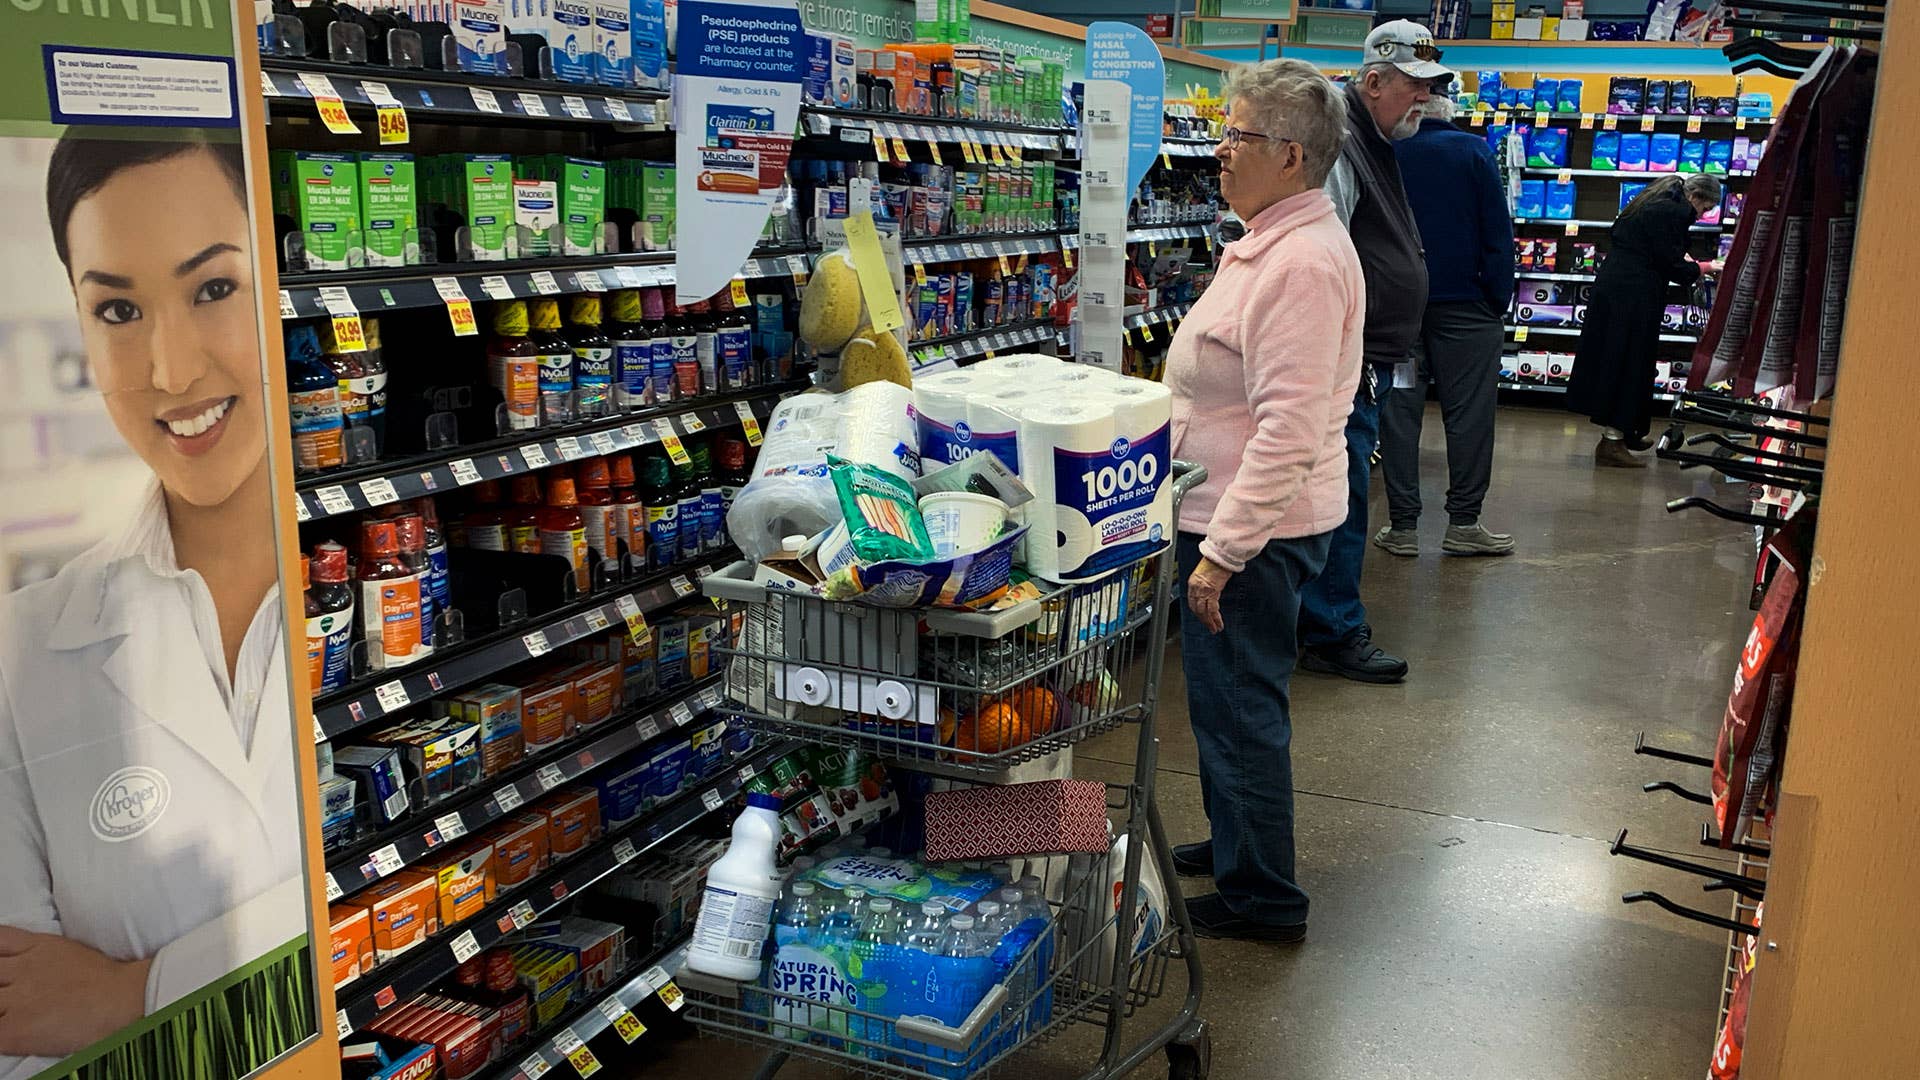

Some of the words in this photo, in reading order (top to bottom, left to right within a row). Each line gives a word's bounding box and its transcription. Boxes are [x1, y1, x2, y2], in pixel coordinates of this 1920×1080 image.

[461, 6, 498, 22] Mucinex
[554, 0, 590, 16] Mucinex
[596, 6, 628, 22] Mucinex
[701, 14, 798, 32] Pseudoephedrine
[819, 4, 859, 33] throat
[861, 10, 913, 41] remedies
[708, 29, 738, 41] (PSE)
[740, 33, 790, 45] products
[1093, 40, 1126, 50] NASAL
[704, 44, 721, 53] are
[723, 44, 762, 56] located
[764, 48, 774, 57] at
[777, 47, 794, 58] the
[1102, 50, 1130, 60] SINUS
[700, 55, 752, 70] Pharmacy
[754, 62, 796, 72] counter.
[1092, 60, 1156, 70] CONGESTION
[1092, 70, 1130, 79] RELIEF?
[744, 86, 761, 95] Cold
[763, 87, 769, 96] &
[770, 88, 781, 97] Flu
[380, 112, 406, 134] 9.49
[540, 368, 570, 382] NyQuil
[580, 361, 608, 374] NyQuil
[1082, 453, 1158, 502] 1000
[1086, 496, 1118, 512] SHEETS
[1120, 490, 1134, 502] PER
[1136, 484, 1156, 496] ROLL
[658, 520, 678, 532] NyQuil
[1102, 510, 1147, 530] LO-O-O-O-ONG
[1102, 524, 1130, 538] LASTING
[1130, 518, 1147, 528] ROLL
[384, 600, 420, 614] DayTime
[455, 742, 476, 758] NyQuil
[425, 753, 449, 770] DayQuil
[105, 784, 155, 819] Kroger
[326, 793, 351, 807] NyQuil
[390, 904, 419, 922] DayTime
[774, 958, 837, 976] NATURAL
[773, 968, 857, 1006] SPRING
[660, 986, 682, 1005] 6.79
[618, 1016, 640, 1037] 6.79
[572, 1052, 594, 1070] 8.99
